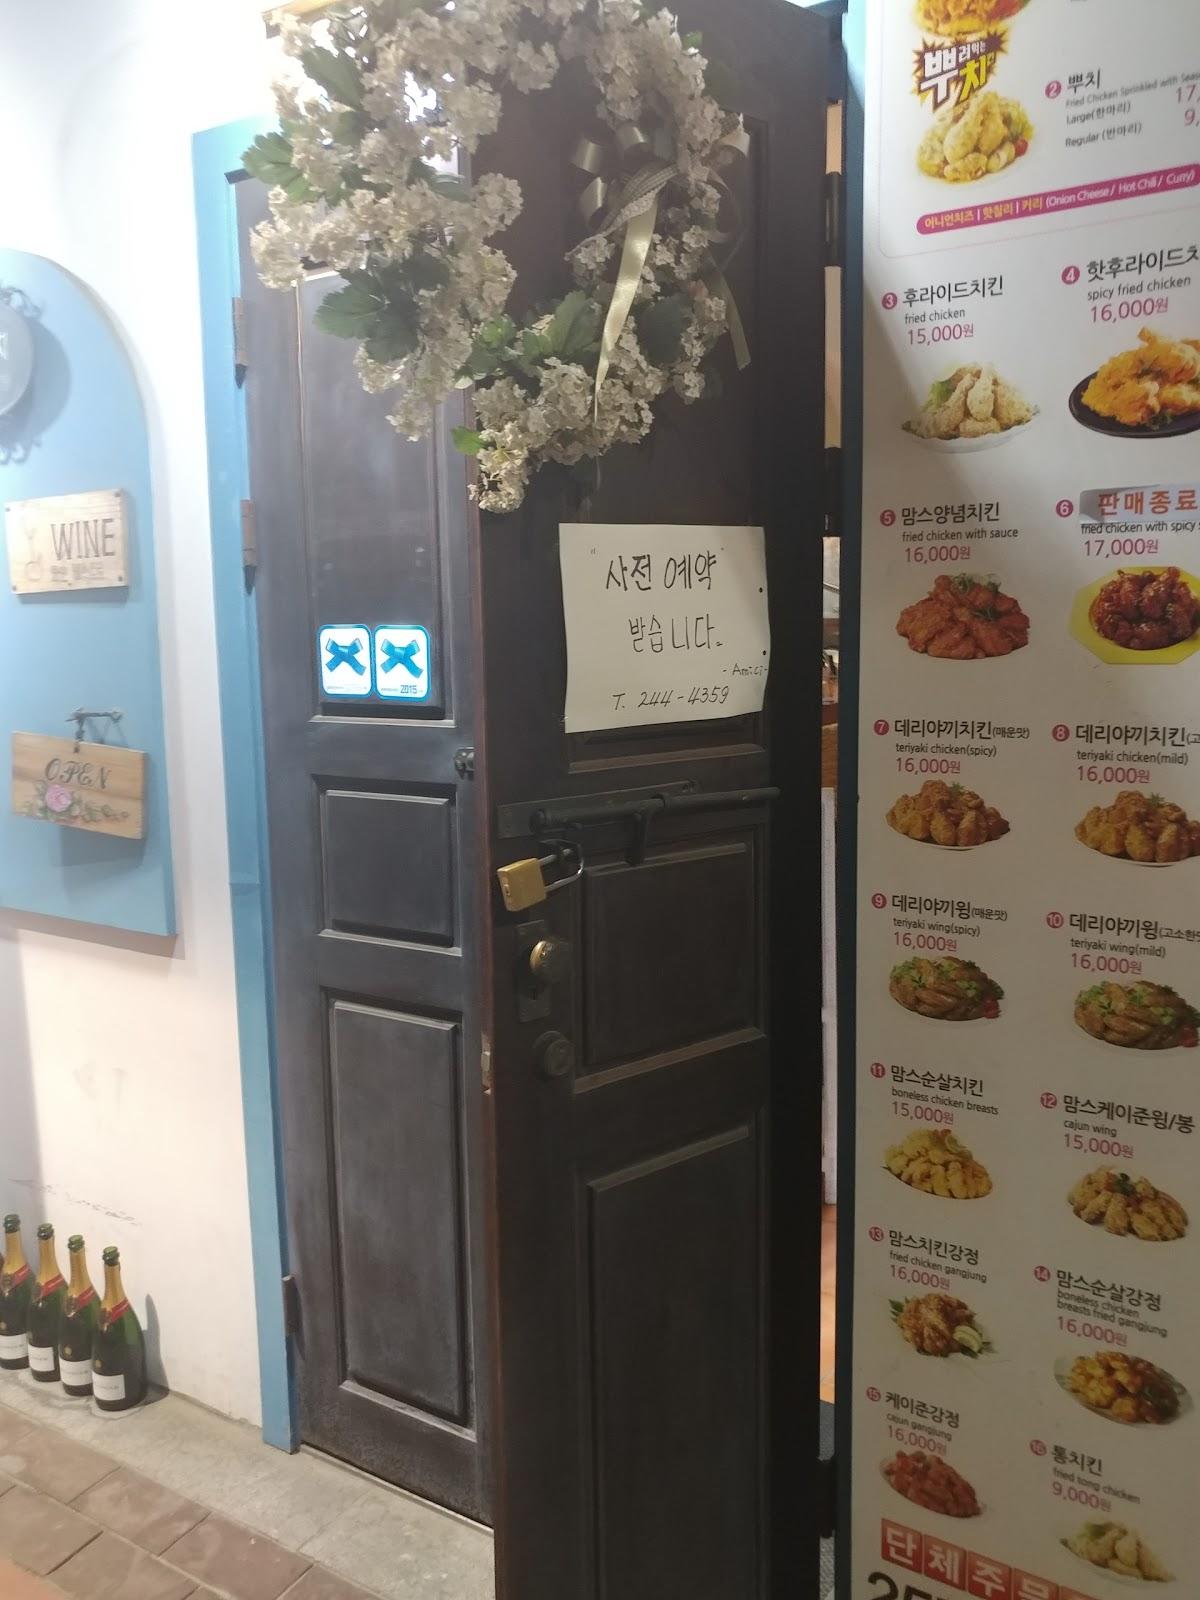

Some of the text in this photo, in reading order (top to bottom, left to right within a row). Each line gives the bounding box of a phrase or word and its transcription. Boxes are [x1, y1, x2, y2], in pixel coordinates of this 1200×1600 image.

[1067, 68, 1101, 94] 뿌치
[1065, 131, 1100, 148] Regular
[903, 275, 1005, 308] 후라이드치킨
[1087, 275, 1192, 302] spicy fried chicken
[904, 307, 966, 325] fried chicken
[1091, 297, 1169, 324] 16,000원
[907, 323, 975, 346] 15,000원
[901, 502, 1000, 526] 맘스양념치킨
[1098, 489, 1199, 517] 판매종료
[902, 528, 1019, 542] fried chicken with sauce
[1105, 522, 1143, 534] chicken
[1145, 521, 1168, 532] with
[1171, 520, 1196, 534] spicy
[50, 518, 115, 561] WINE
[1084, 538, 1159, 558] 17,000원
[905, 545, 971, 564] 16,000원
[896, 743, 997, 757] teriyaki chicken(spicy)
[1077, 750, 1189, 766] teriyaki chicken(mild)
[896, 757, 961, 775] 16,000원
[1077, 765, 1151, 784] 16,000원
[893, 917, 926, 930] teriyaki
[894, 931, 957, 952] 16,000원
[1070, 937, 1107, 951] teriyaki
[1071, 952, 1142, 975] 16,000원
[890, 1064, 983, 1098] 맘스순살치킨
[891, 1086, 1000, 1116] boneless chicken breasts
[892, 1101, 954, 1125] 15,000원
[1063, 1094, 1196, 1134] 맘스케이준윙/봉
[1063, 1118, 1118, 1138] cajun wing
[1063, 1133, 1134, 1158] 15,000원
[889, 1229, 979, 1266] 맘스치킨강정
[889, 1250, 909, 1263] fried
[910, 1255, 943, 1272] chicken
[890, 1264, 950, 1290] 16,000원
[1056, 1269, 1161, 1312] 맘스순살강정
[1057, 1288, 1099, 1309] boneless
[1056, 1299, 1091, 1317] breasts
[1058, 1316, 1129, 1347] 16,000원
[885, 1391, 960, 1429] 케이준강정
[887, 1425, 948, 1454] 16,000원
[1052, 1445, 1103, 1477] 통치킨
[1052, 1481, 1113, 1512] 9,000원
